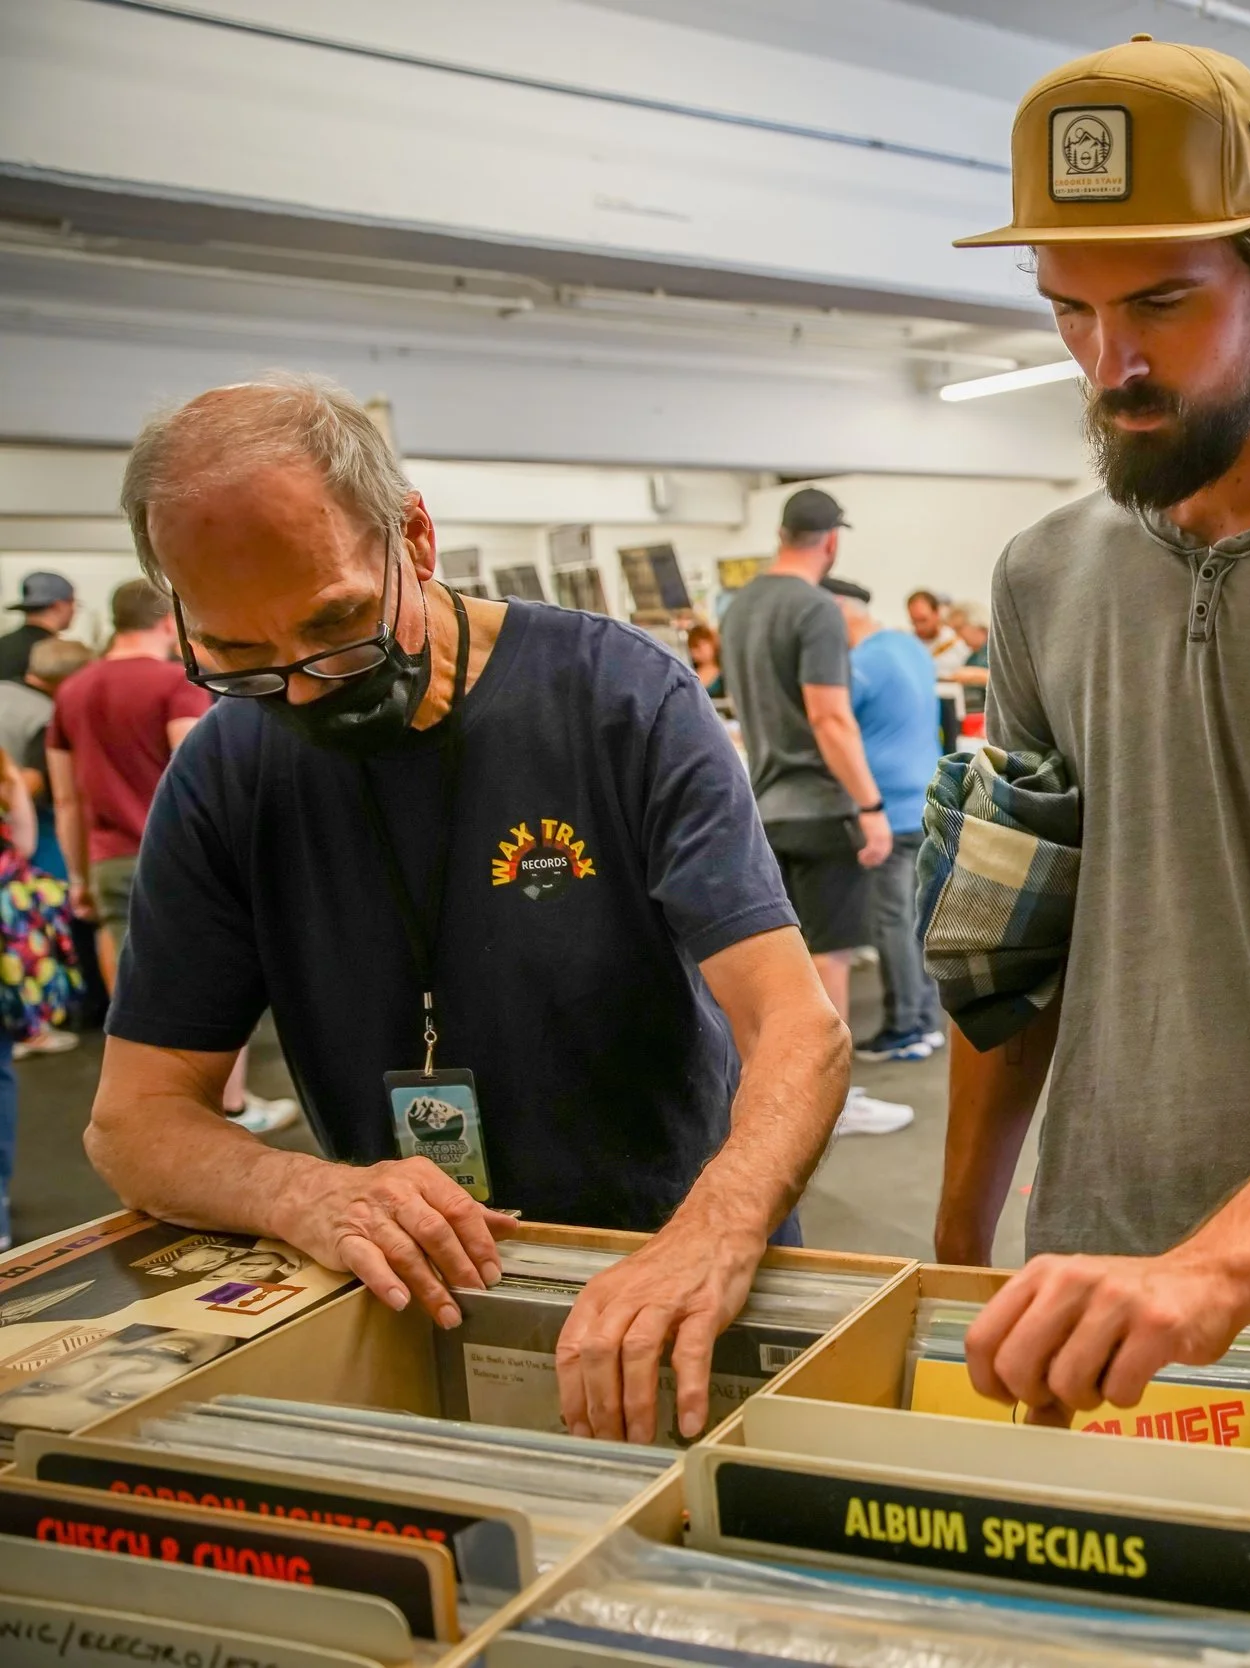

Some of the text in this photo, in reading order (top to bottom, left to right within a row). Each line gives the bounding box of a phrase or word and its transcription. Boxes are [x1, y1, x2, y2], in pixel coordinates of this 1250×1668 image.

[492, 818, 597, 887] WAX TRAX
[521, 857, 568, 871] RECORDS
[415, 1143, 468, 1155] RECORD
[843, 1496, 1148, 1577] ALBUM SPECIALS
[193, 1542, 313, 1588] CHONG
